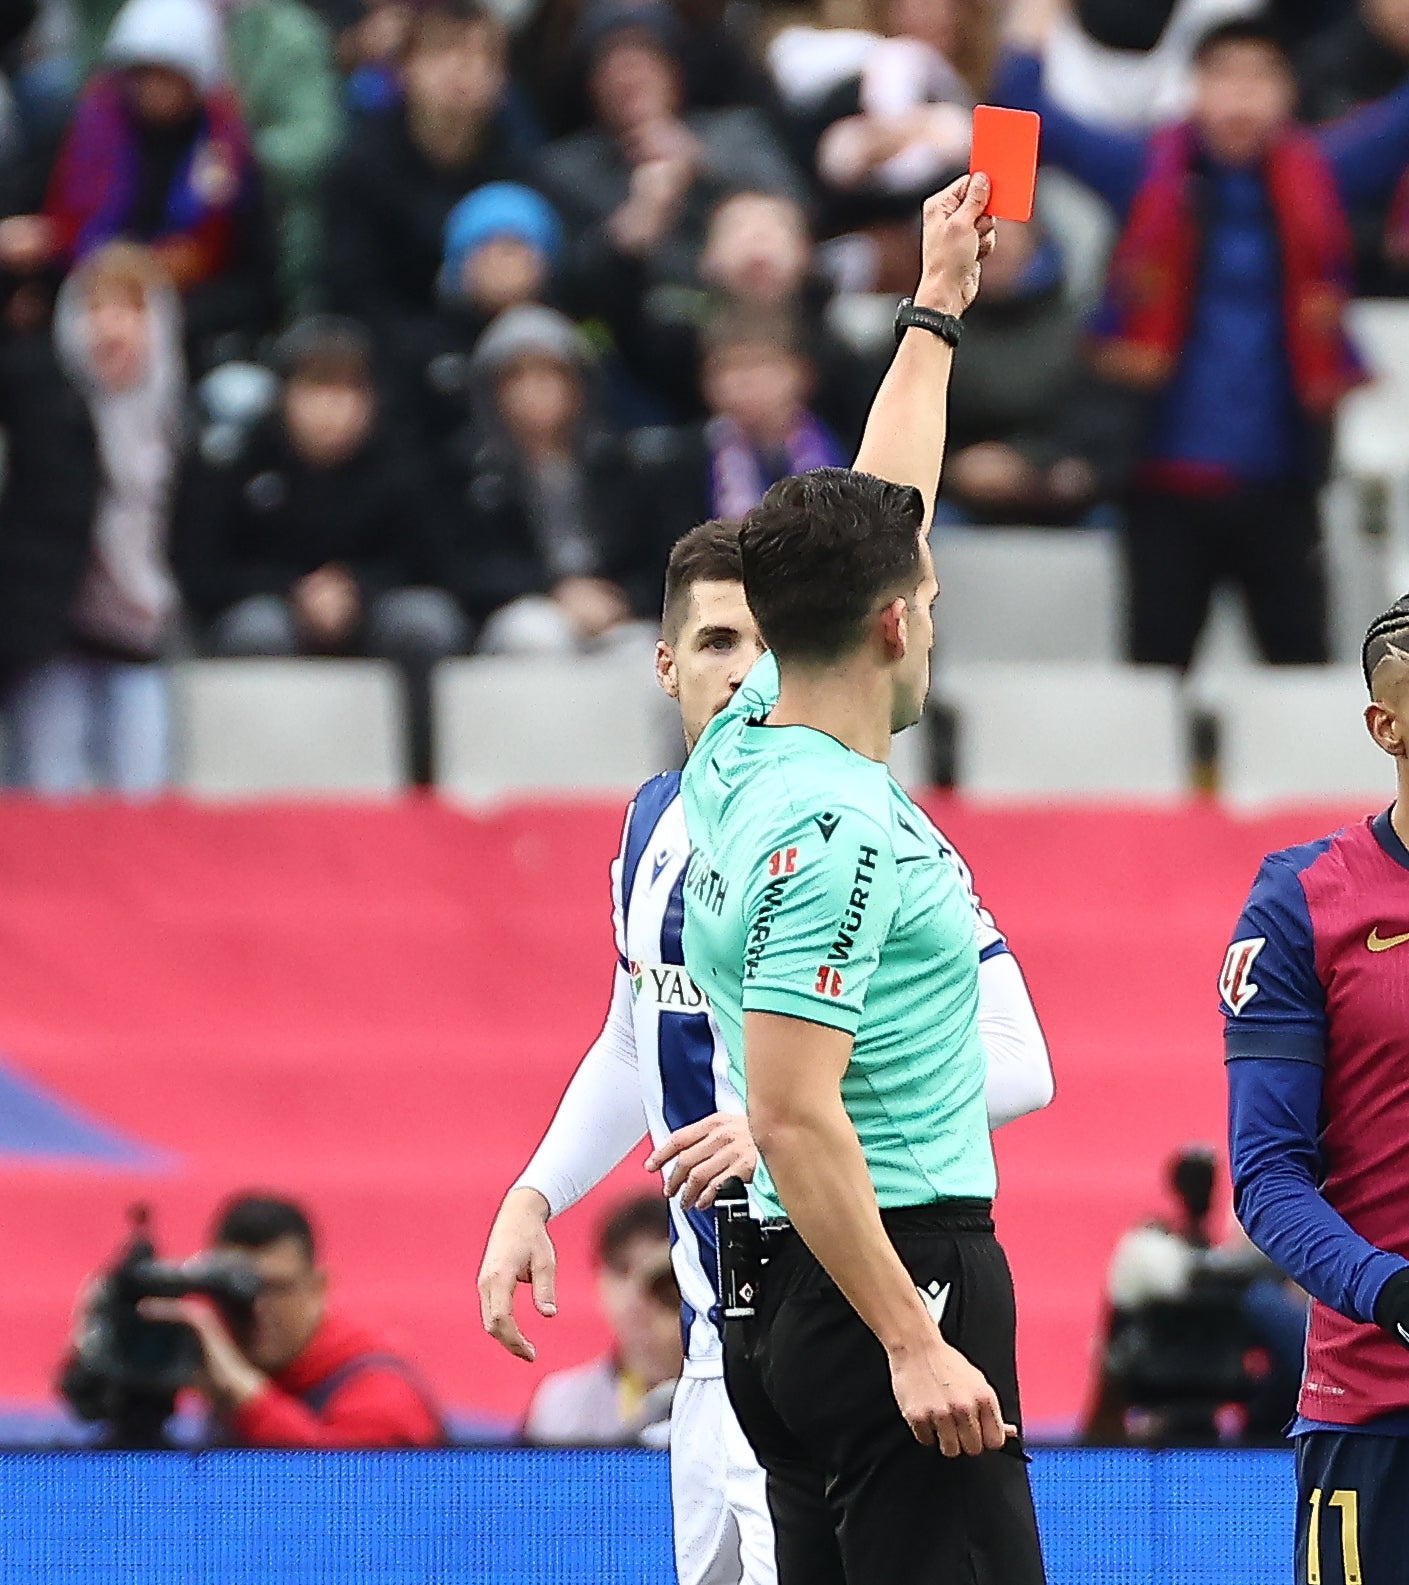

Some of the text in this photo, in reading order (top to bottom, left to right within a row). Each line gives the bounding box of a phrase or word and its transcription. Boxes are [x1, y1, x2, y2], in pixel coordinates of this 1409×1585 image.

[687, 848, 729, 916] ÜRTH
[827, 845, 879, 960] WÜRTH
[650, 967, 712, 1008] YAS
[1307, 1487, 1363, 1585] 11
